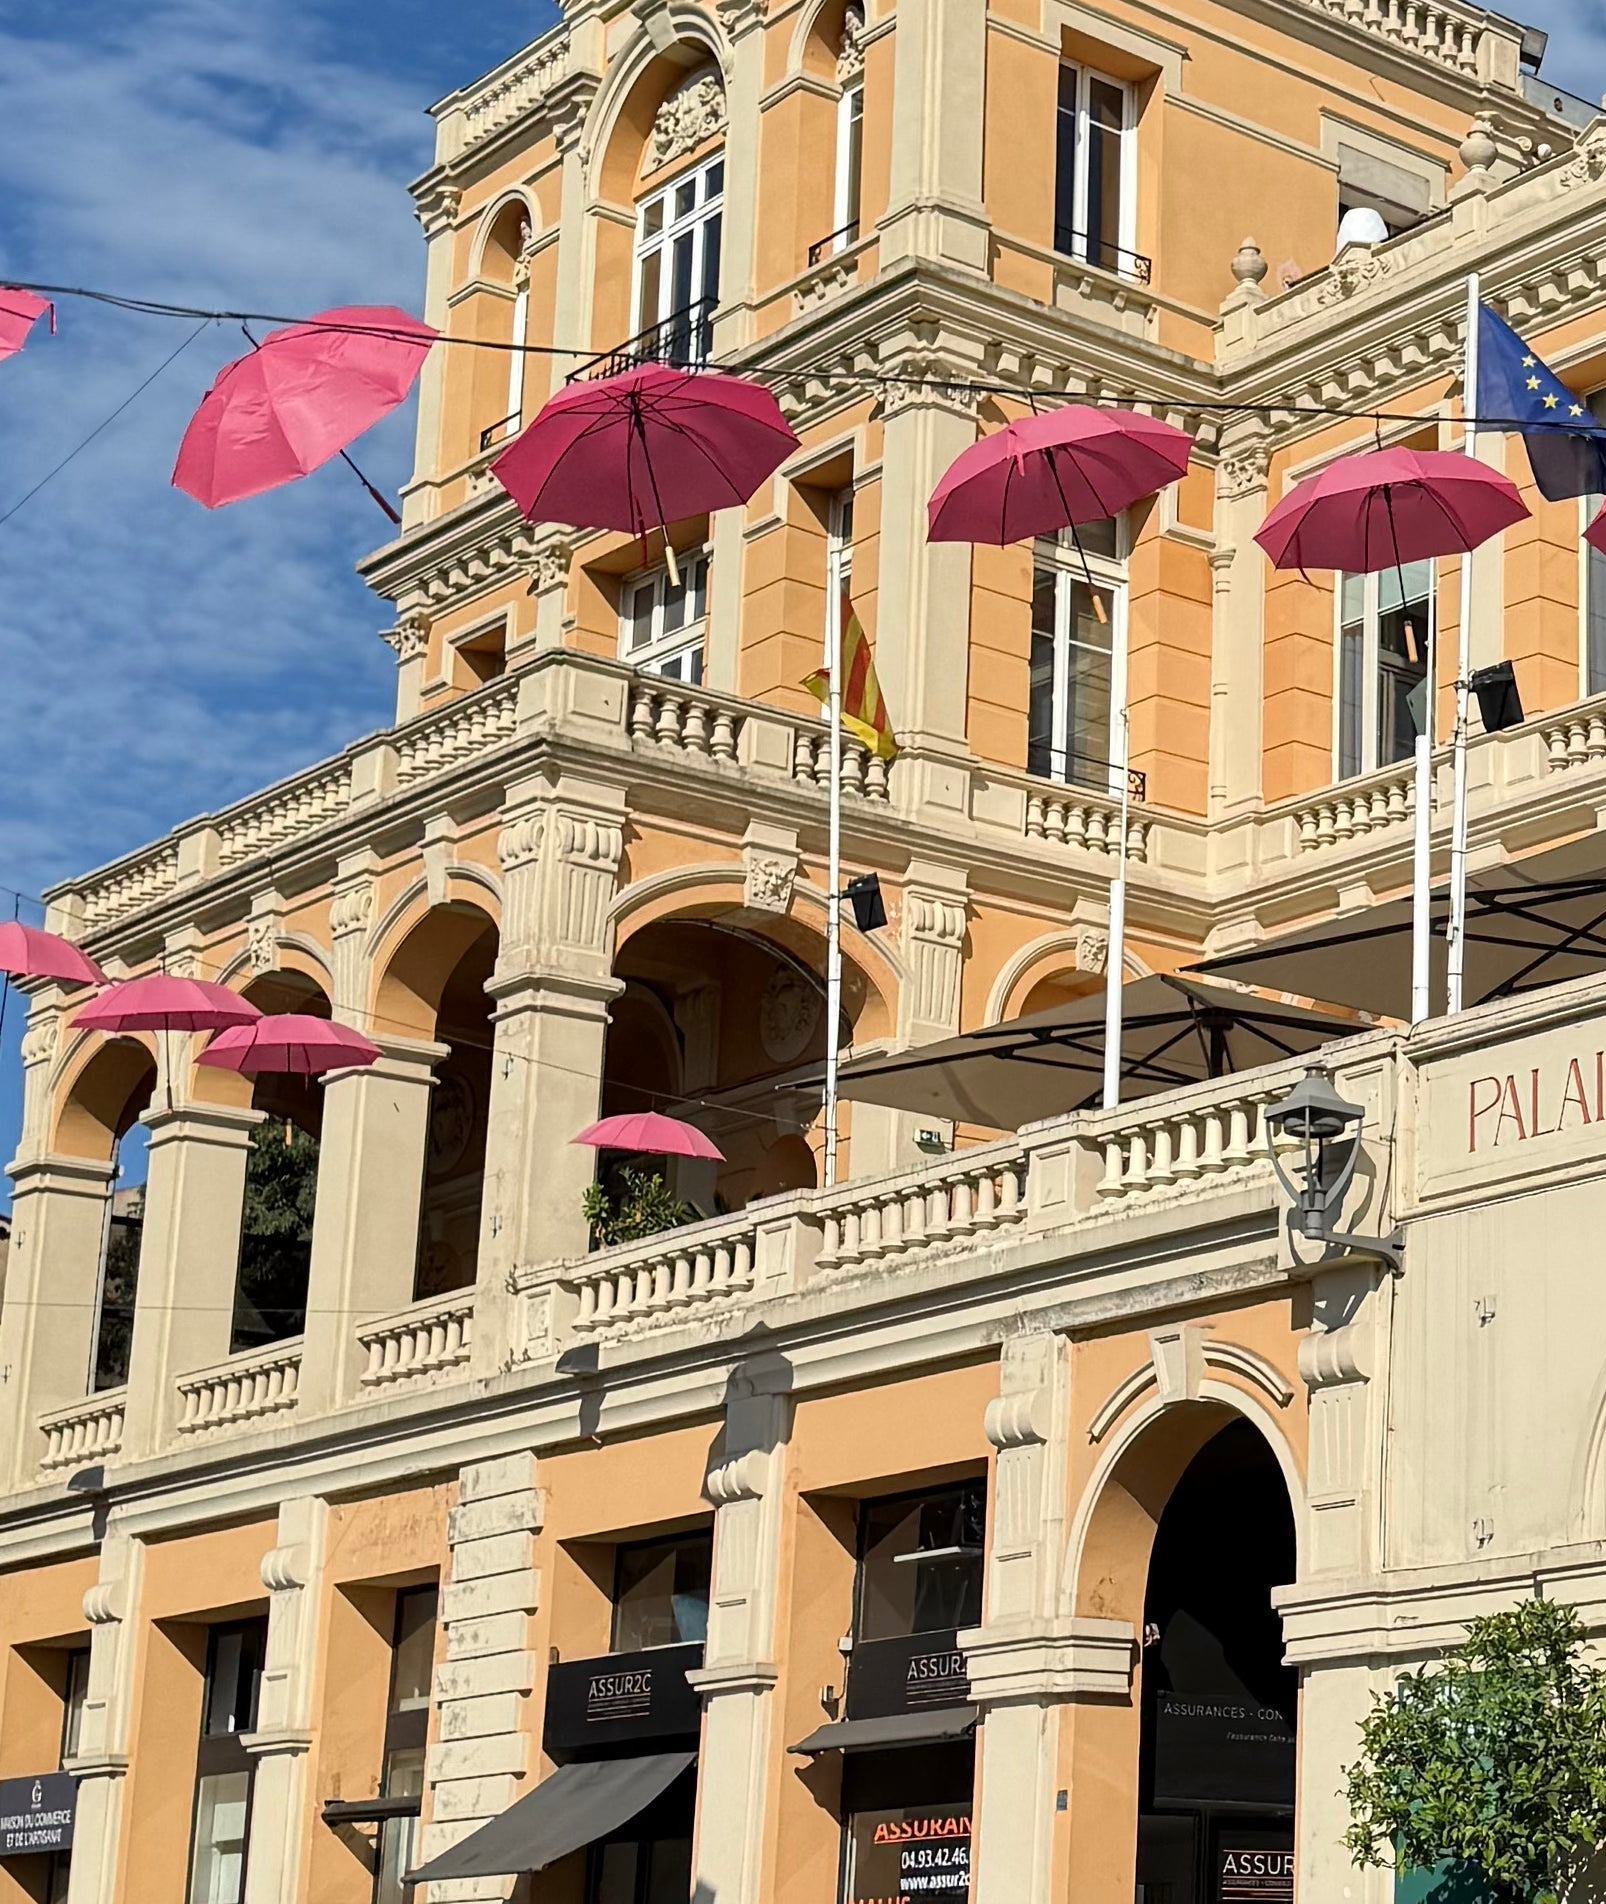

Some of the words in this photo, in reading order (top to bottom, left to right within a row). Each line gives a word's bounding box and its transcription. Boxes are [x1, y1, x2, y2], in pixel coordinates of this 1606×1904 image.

[907, 1656, 965, 1680] ASSUR
[588, 1673, 652, 1698] ASSUR2C
[1163, 1702, 1246, 1719] ASSURANCES
